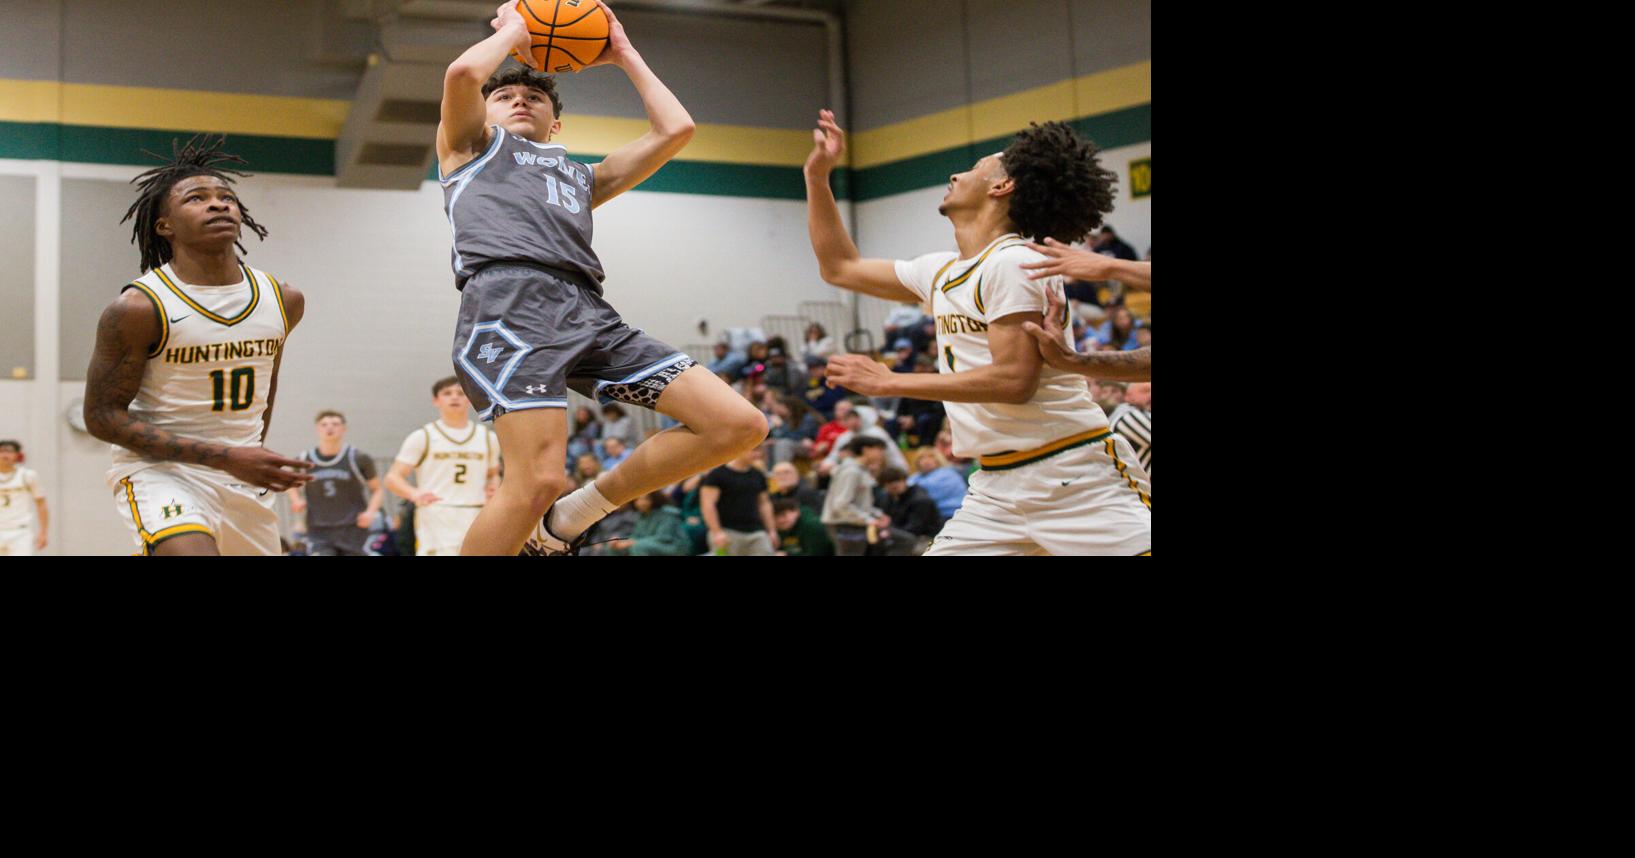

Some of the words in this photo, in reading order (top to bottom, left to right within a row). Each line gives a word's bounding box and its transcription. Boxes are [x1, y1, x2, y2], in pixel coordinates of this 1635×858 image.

[512, 151, 591, 194] WOLVE
[543, 173, 580, 214] 15
[208, 366, 256, 413] 10
[453, 463, 468, 485] 2
